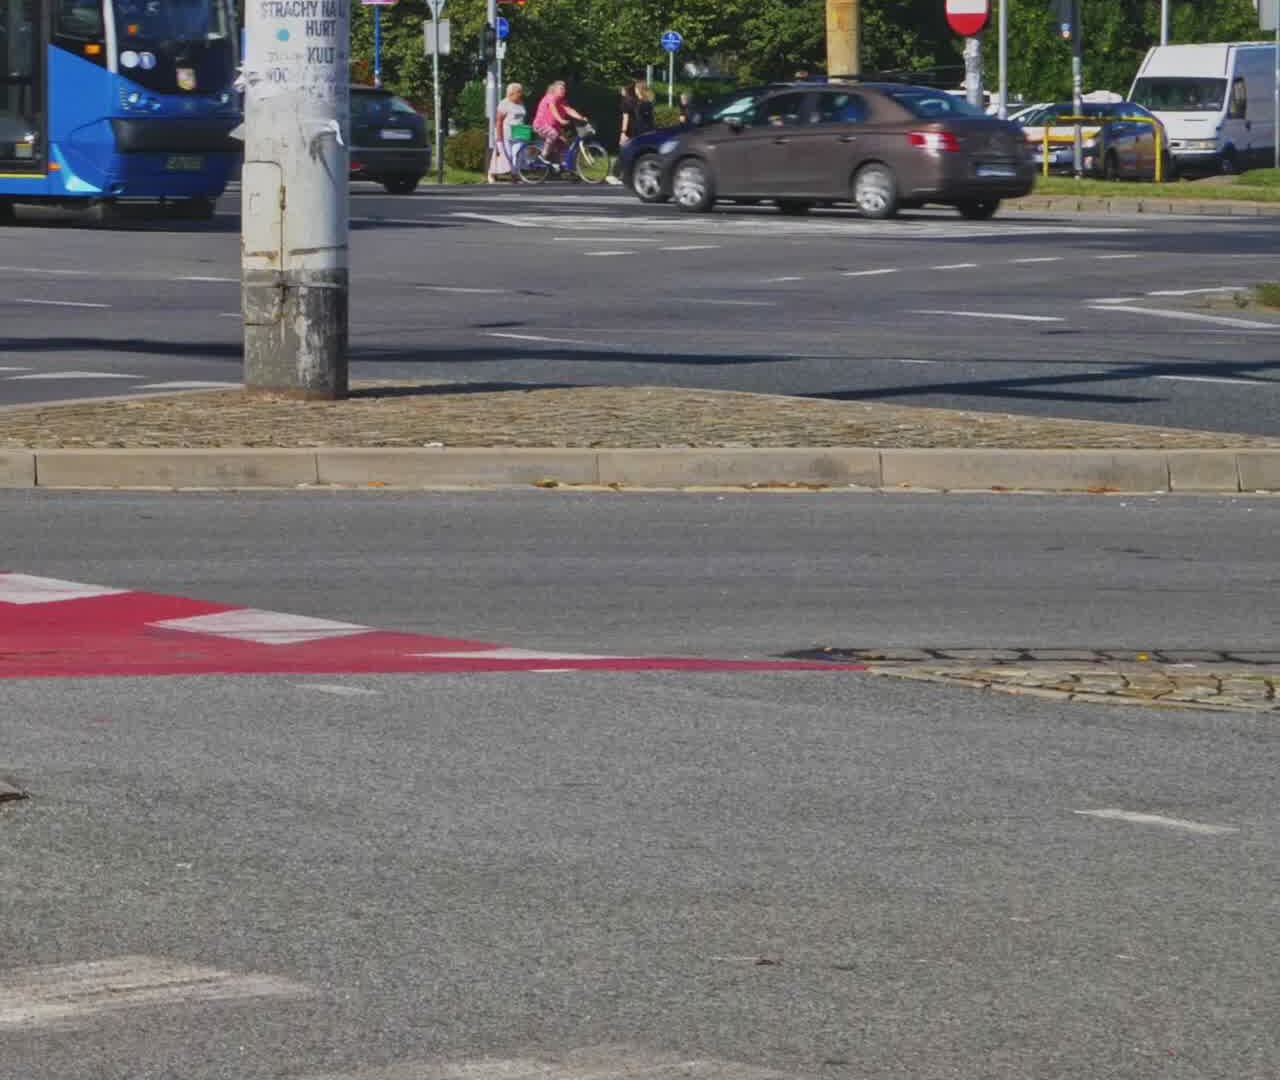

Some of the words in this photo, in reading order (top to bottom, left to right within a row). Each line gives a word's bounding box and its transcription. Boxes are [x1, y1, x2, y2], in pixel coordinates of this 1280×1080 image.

[261, 1, 318, 19] STRACHY
[306, 21, 337, 37] HURT
[307, 47, 336, 65] KULT
